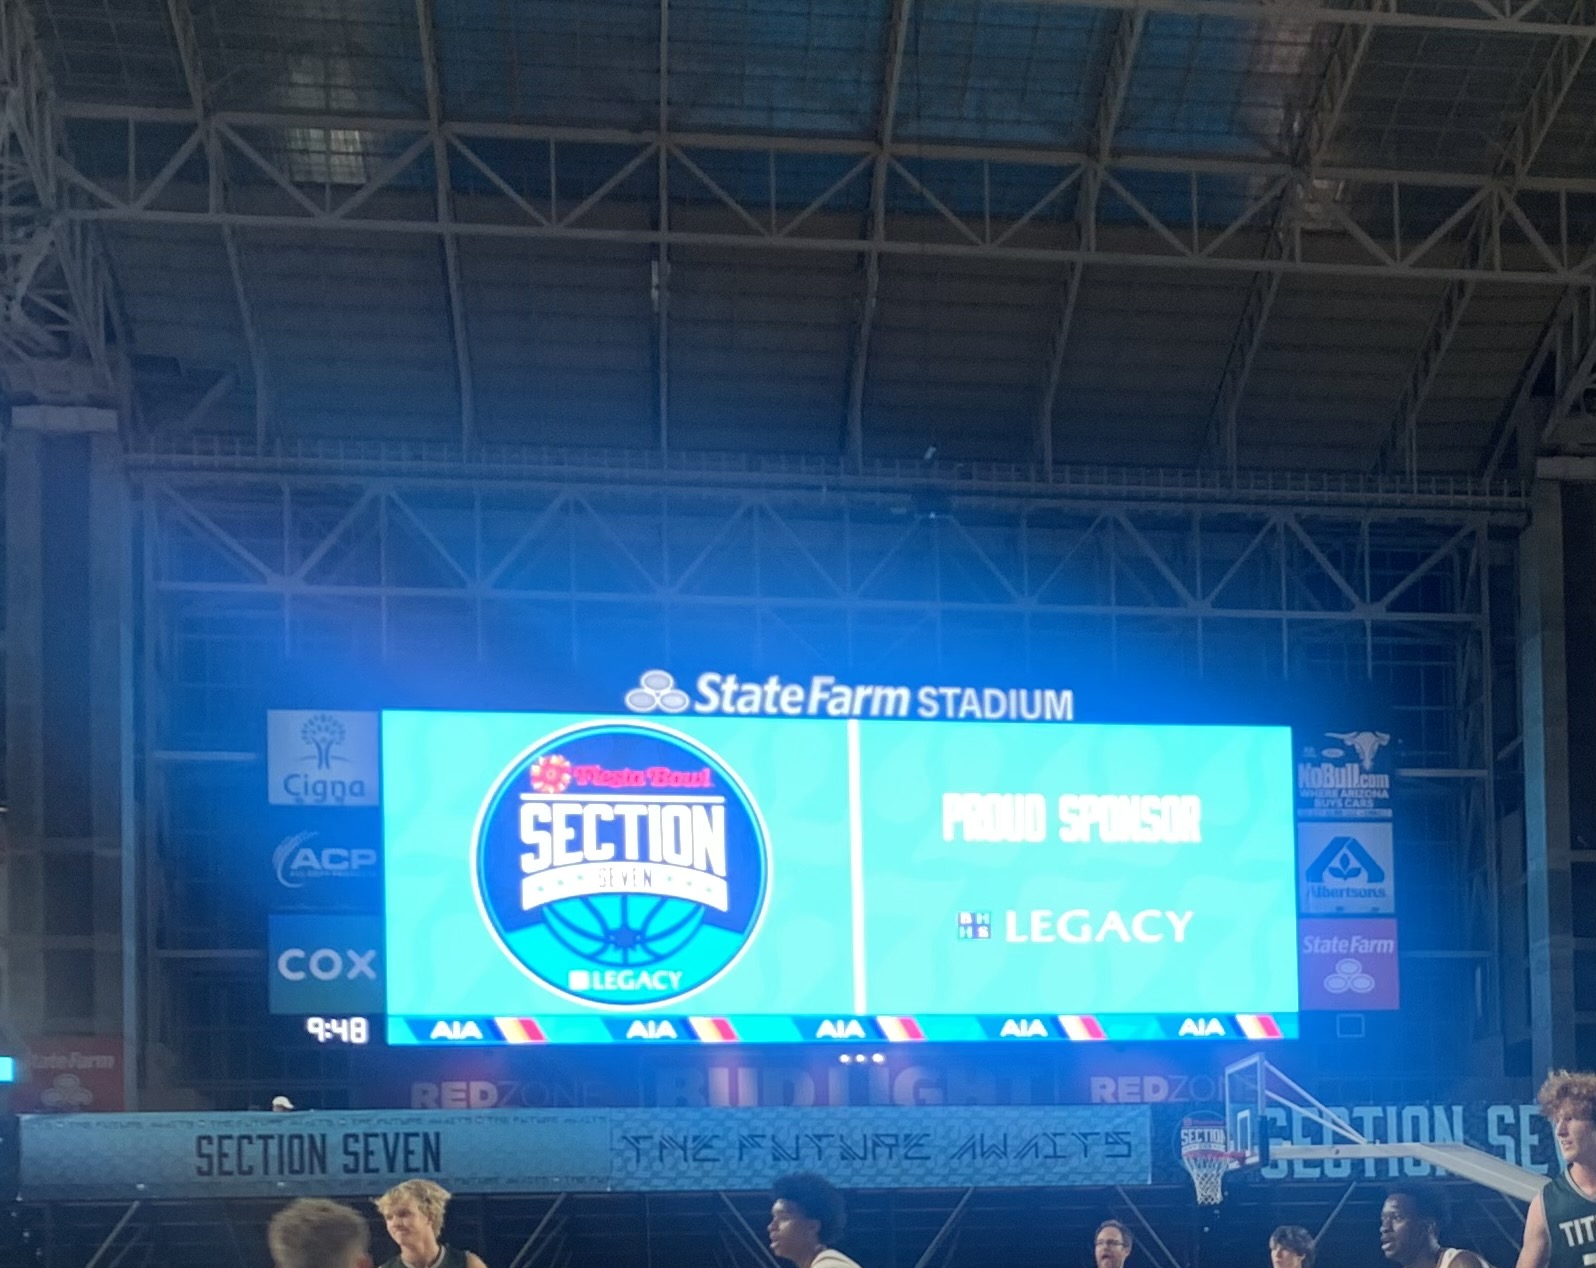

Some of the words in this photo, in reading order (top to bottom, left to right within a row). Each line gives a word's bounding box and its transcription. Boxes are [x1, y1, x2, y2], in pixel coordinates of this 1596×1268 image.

[917, 687, 1075, 721] STADIUM
[283, 773, 366, 801] Cigna
[1298, 762, 1390, 789] NoBull.com
[1340, 789, 1390, 800] ARIZONA
[1345, 799, 1374, 808] CARS
[943, 793, 1047, 842] PROUD
[1058, 794, 1202, 843] SPONSOR
[520, 803, 727, 877] SECTION
[290, 848, 377, 870] ACP
[599, 867, 652, 888] SEVEN
[1307, 884, 1386, 898] Albertsons
[1006, 909, 1195, 944] LEGACY
[278, 948, 377, 982] COX
[592, 970, 683, 991] LEGACY
[307, 1016, 369, 1044] 9:48
[431, 1020, 483, 1040] AIA
[626, 1020, 678, 1039] AIA
[816, 1019, 866, 1039] AIA
[1001, 1018, 1048, 1038] AIA
[1178, 1017, 1226, 1037] AIA
[655, 1066, 815, 1107] BUD
[195, 1134, 327, 1177] SECTION
[343, 1131, 443, 1174] SEVEN
[622, 1134, 720, 1163] THE
[738, 1133, 932, 1162] FUTURE
[951, 1131, 1133, 1161] AWAITS
